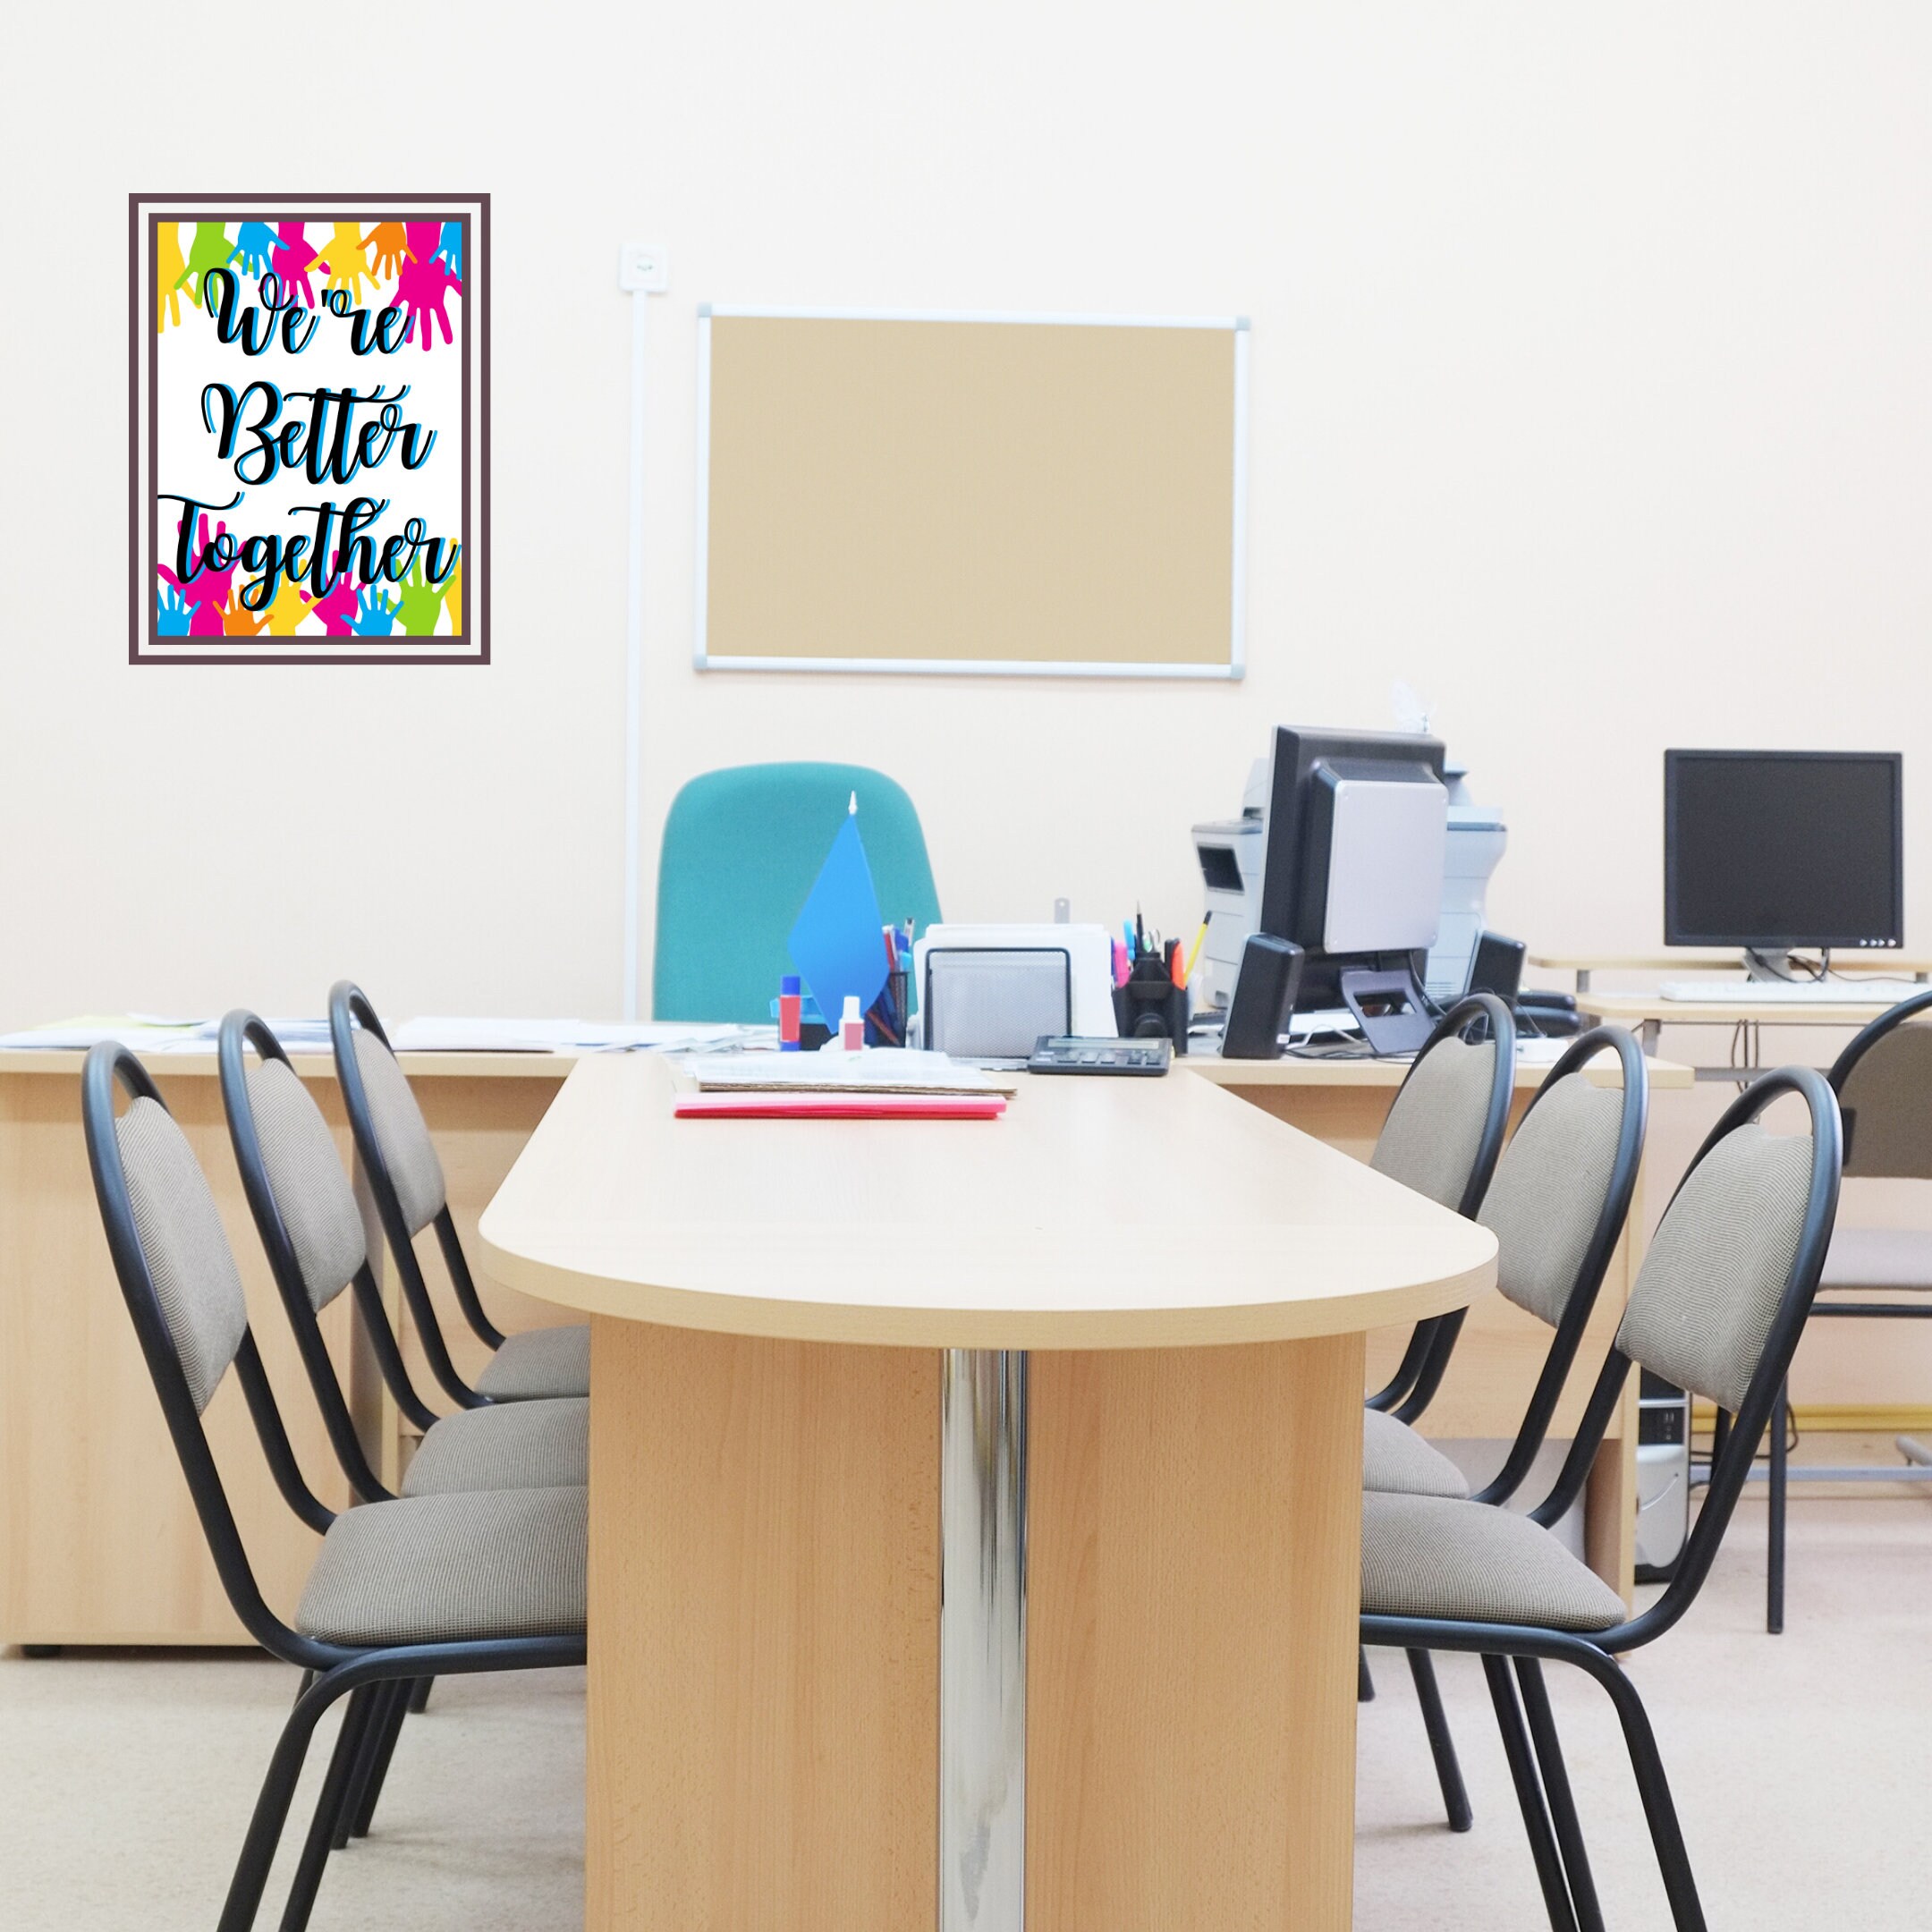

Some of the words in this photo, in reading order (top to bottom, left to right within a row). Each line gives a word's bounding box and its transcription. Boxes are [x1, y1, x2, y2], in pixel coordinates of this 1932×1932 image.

[203, 267, 415, 356] We're
[201, 381, 437, 485] Better
[157, 491, 462, 612] Together
